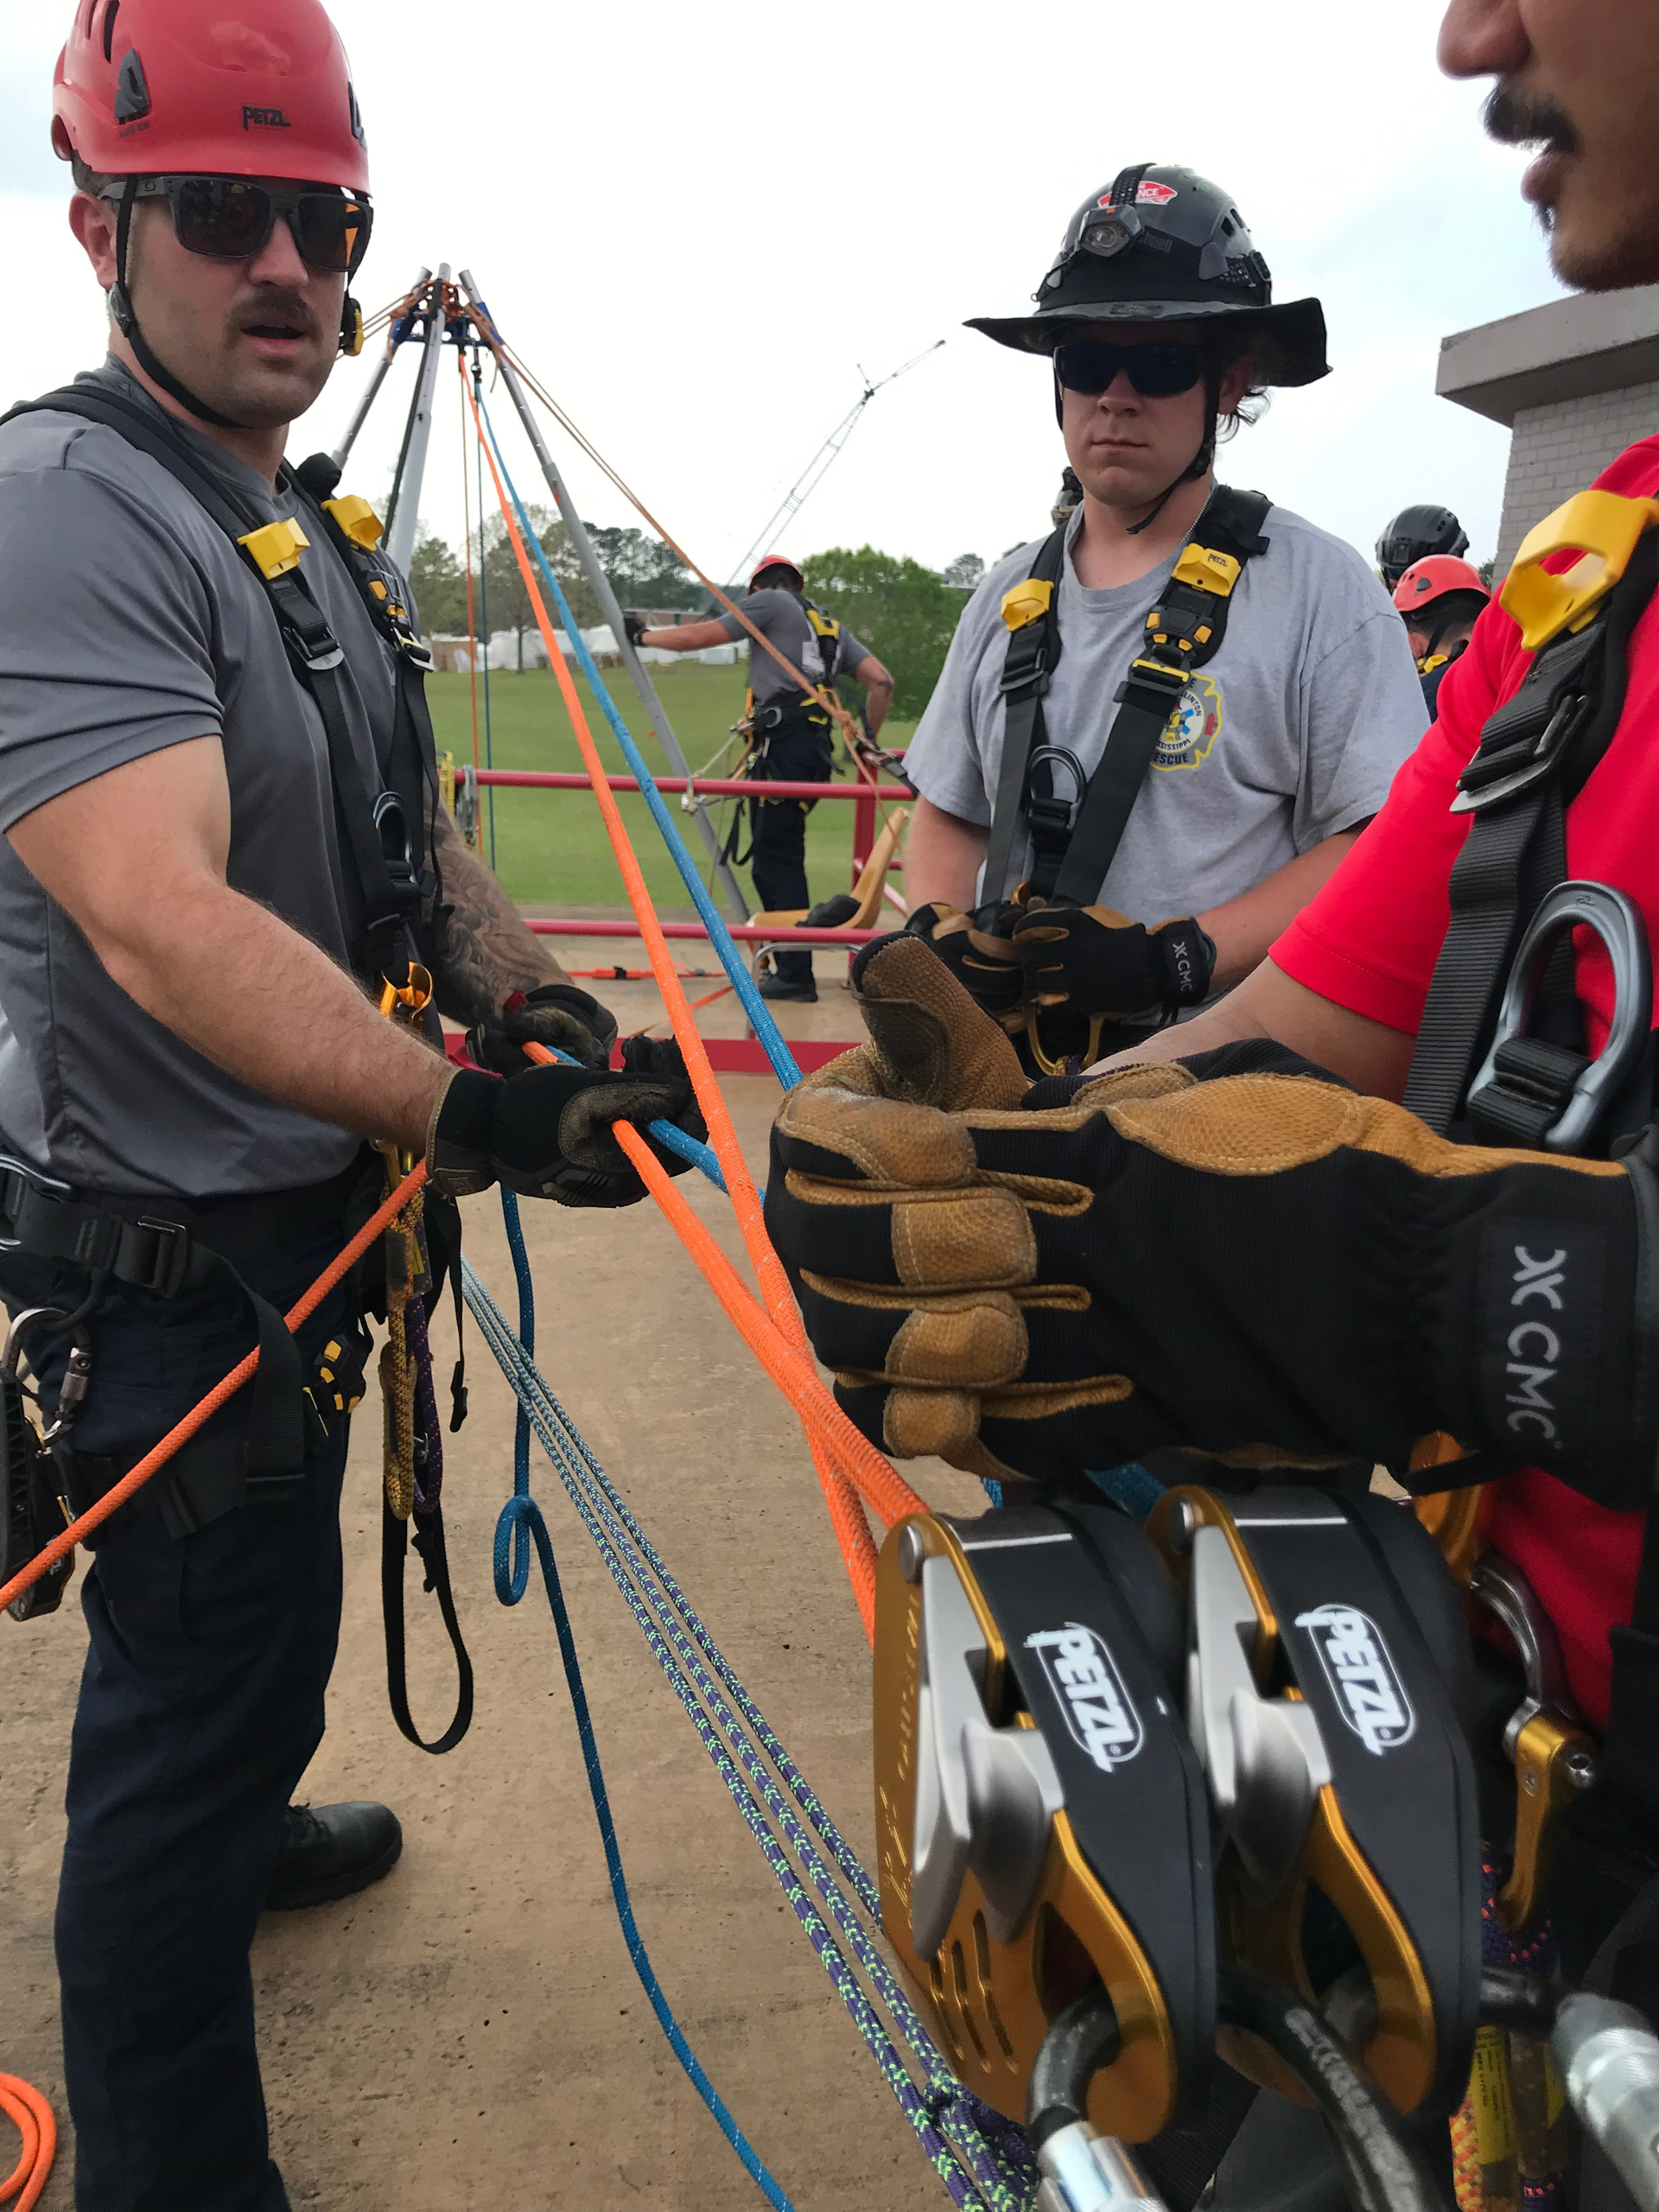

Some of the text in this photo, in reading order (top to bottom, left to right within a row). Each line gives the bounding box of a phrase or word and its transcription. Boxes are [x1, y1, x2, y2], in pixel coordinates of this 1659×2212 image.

[243, 106, 291, 130] PETZL
[1154, 753, 1189, 765] ESCUE
[1177, 959, 1192, 993] CMC
[1505, 1321, 1560, 1440] CMC
[1023, 1626, 1135, 1773] PETZL
[1294, 1611, 1407, 1756] PETZL
